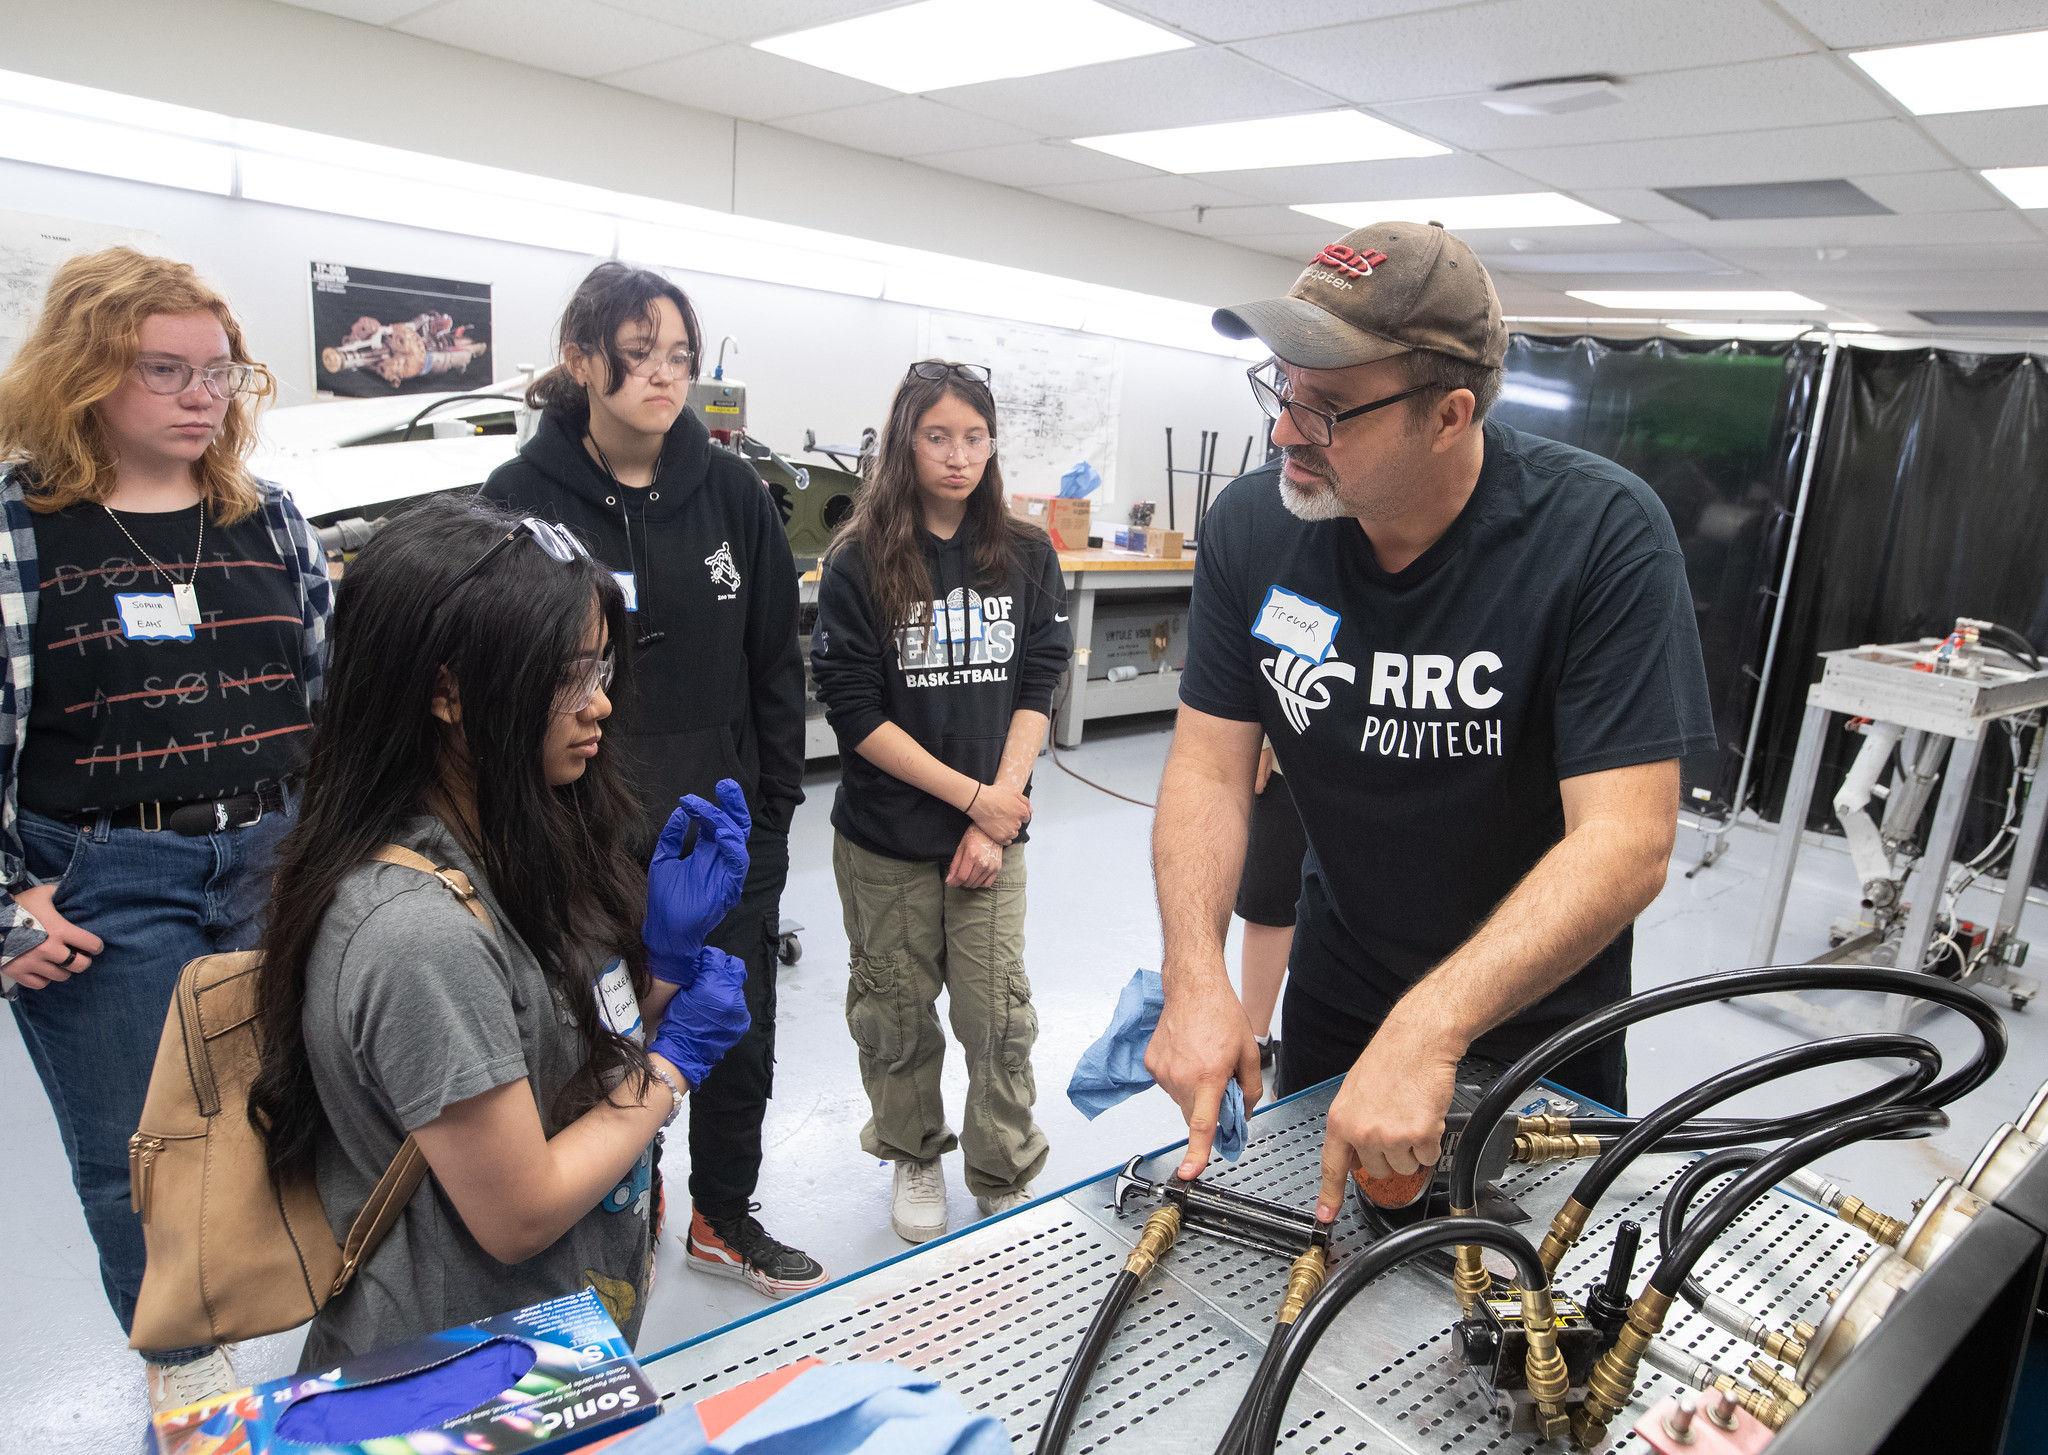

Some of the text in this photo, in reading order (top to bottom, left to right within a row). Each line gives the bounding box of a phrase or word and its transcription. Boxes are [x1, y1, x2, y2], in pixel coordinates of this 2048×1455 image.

[983, 596, 1013, 621] OF
[65, 610, 224, 656] TRT
[905, 668, 1008, 688] BASKETBALL
[1370, 650, 1504, 710] RRC
[1360, 715, 1503, 760] POLYTECH
[582, 1346, 604, 1363] S
[541, 1385, 640, 1432] Sonic
